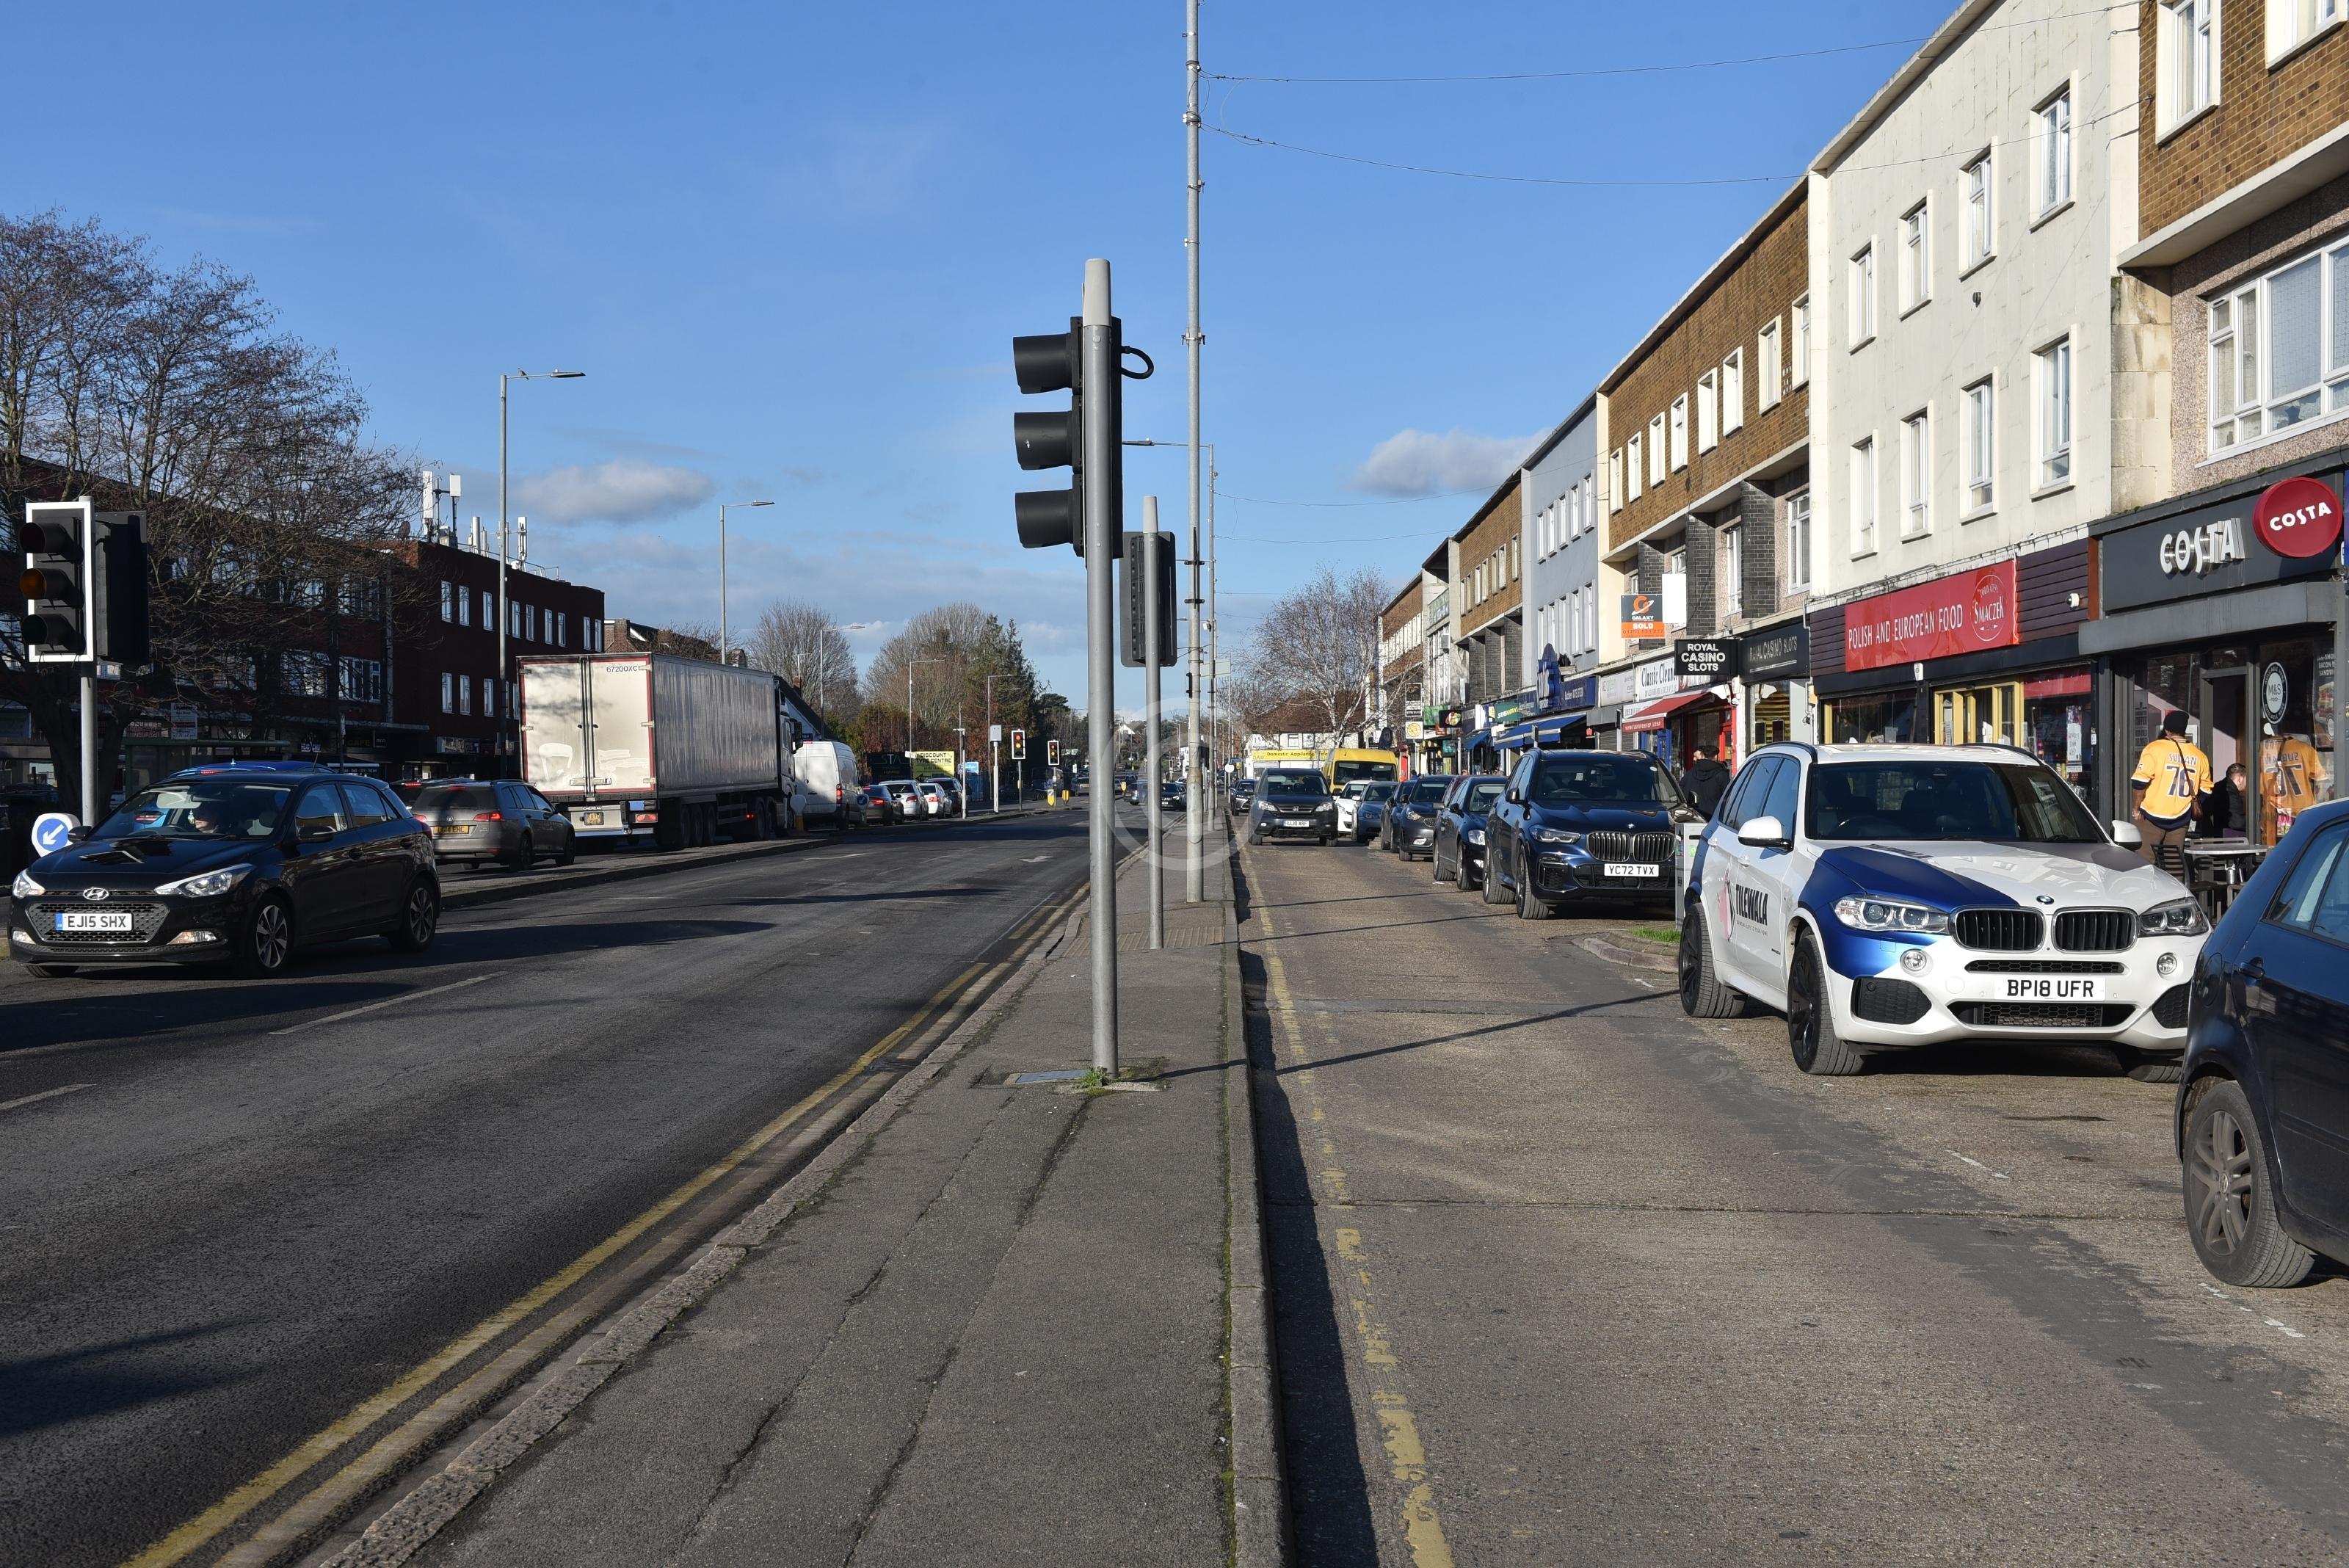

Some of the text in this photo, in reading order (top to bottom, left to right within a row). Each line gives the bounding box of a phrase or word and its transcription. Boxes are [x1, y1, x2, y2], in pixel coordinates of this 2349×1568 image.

[2269, 501, 2332, 531] COSTA
[2160, 518, 2241, 574] COSTA
[1848, 604, 1964, 650] POLISH AND EUROPEAN FOOD
[1687, 643, 1719, 652] ROYAL
[1762, 637, 1782, 660] CASINO
[1783, 636, 1798, 653] SLOTS
[1681, 652, 1726, 662] CASINO
[1688, 663, 1719, 672] SLOTS
[1641, 666, 1658, 688] Classic
[2268, 683, 2281, 695] M&S
[1497, 706, 1518, 719] SUBWAY
[2166, 764, 2196, 798] 76
[1609, 865, 1655, 875] YC72 TVX
[1735, 884, 1768, 926] TILEWALA
[68, 915, 126, 928] EJ15 SHX
[2007, 979, 2094, 997] BP18 UFR
